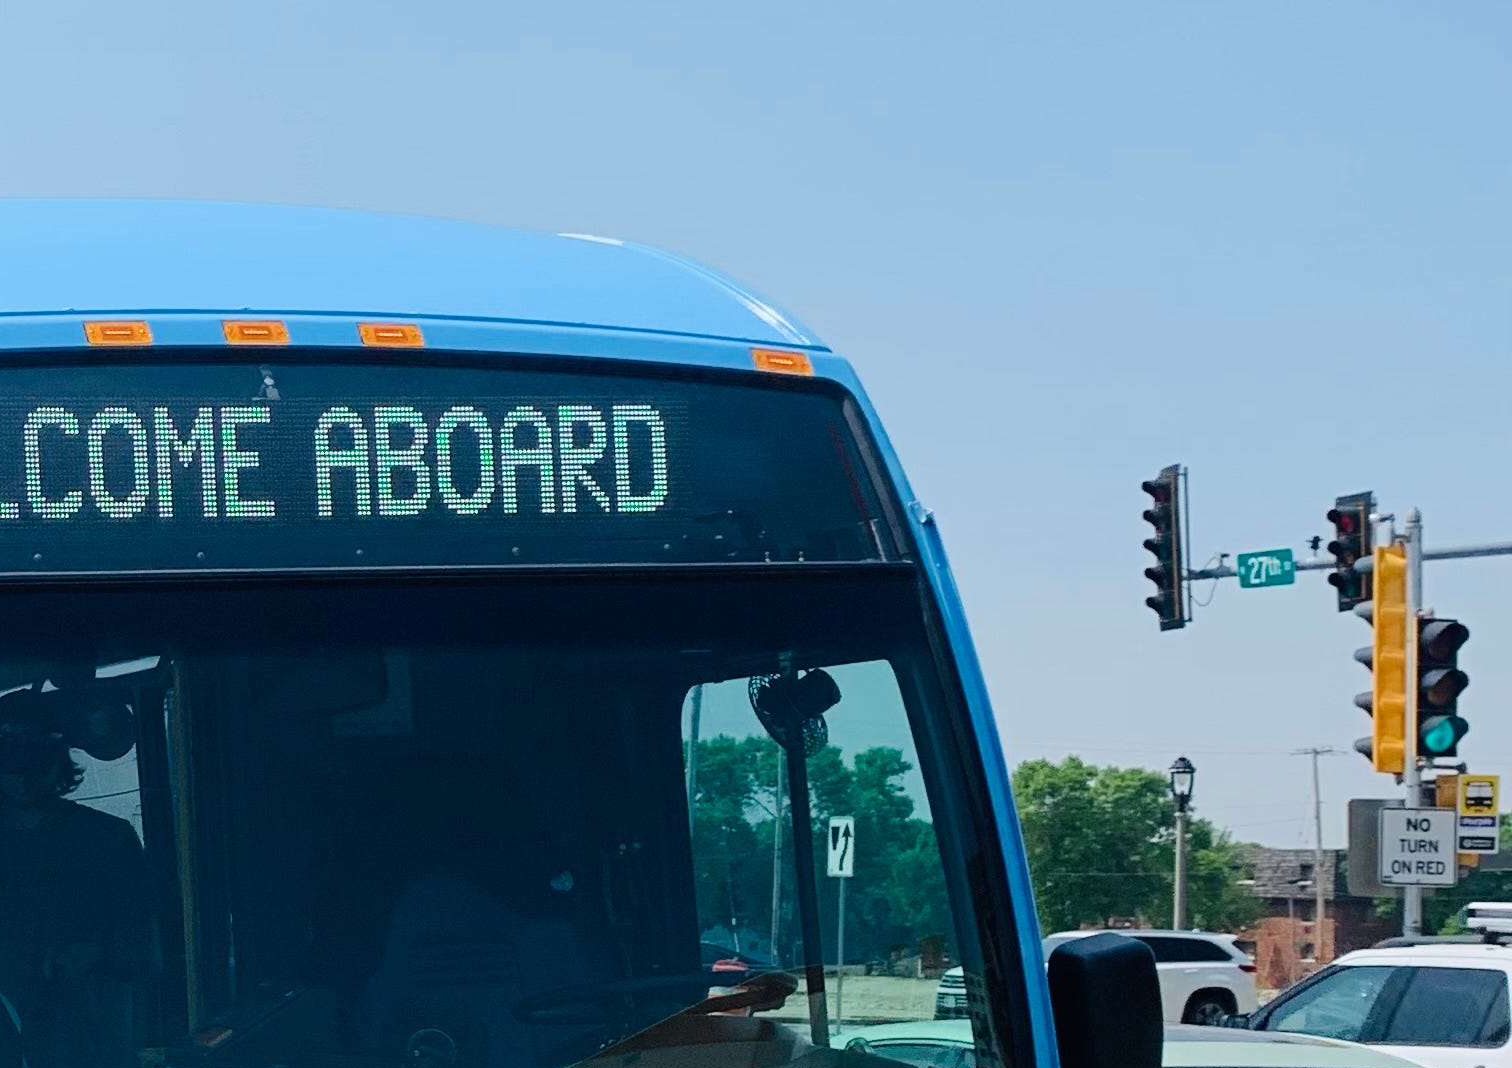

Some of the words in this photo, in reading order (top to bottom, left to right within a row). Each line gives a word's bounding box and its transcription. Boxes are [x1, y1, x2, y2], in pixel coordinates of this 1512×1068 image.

[314, 404, 670, 516] ABOARD
[1406, 818, 1431, 832] NO
[1400, 839, 1439, 853] TURN
[1391, 860, 1412, 875] ON
[1416, 860, 1445, 875] RED
